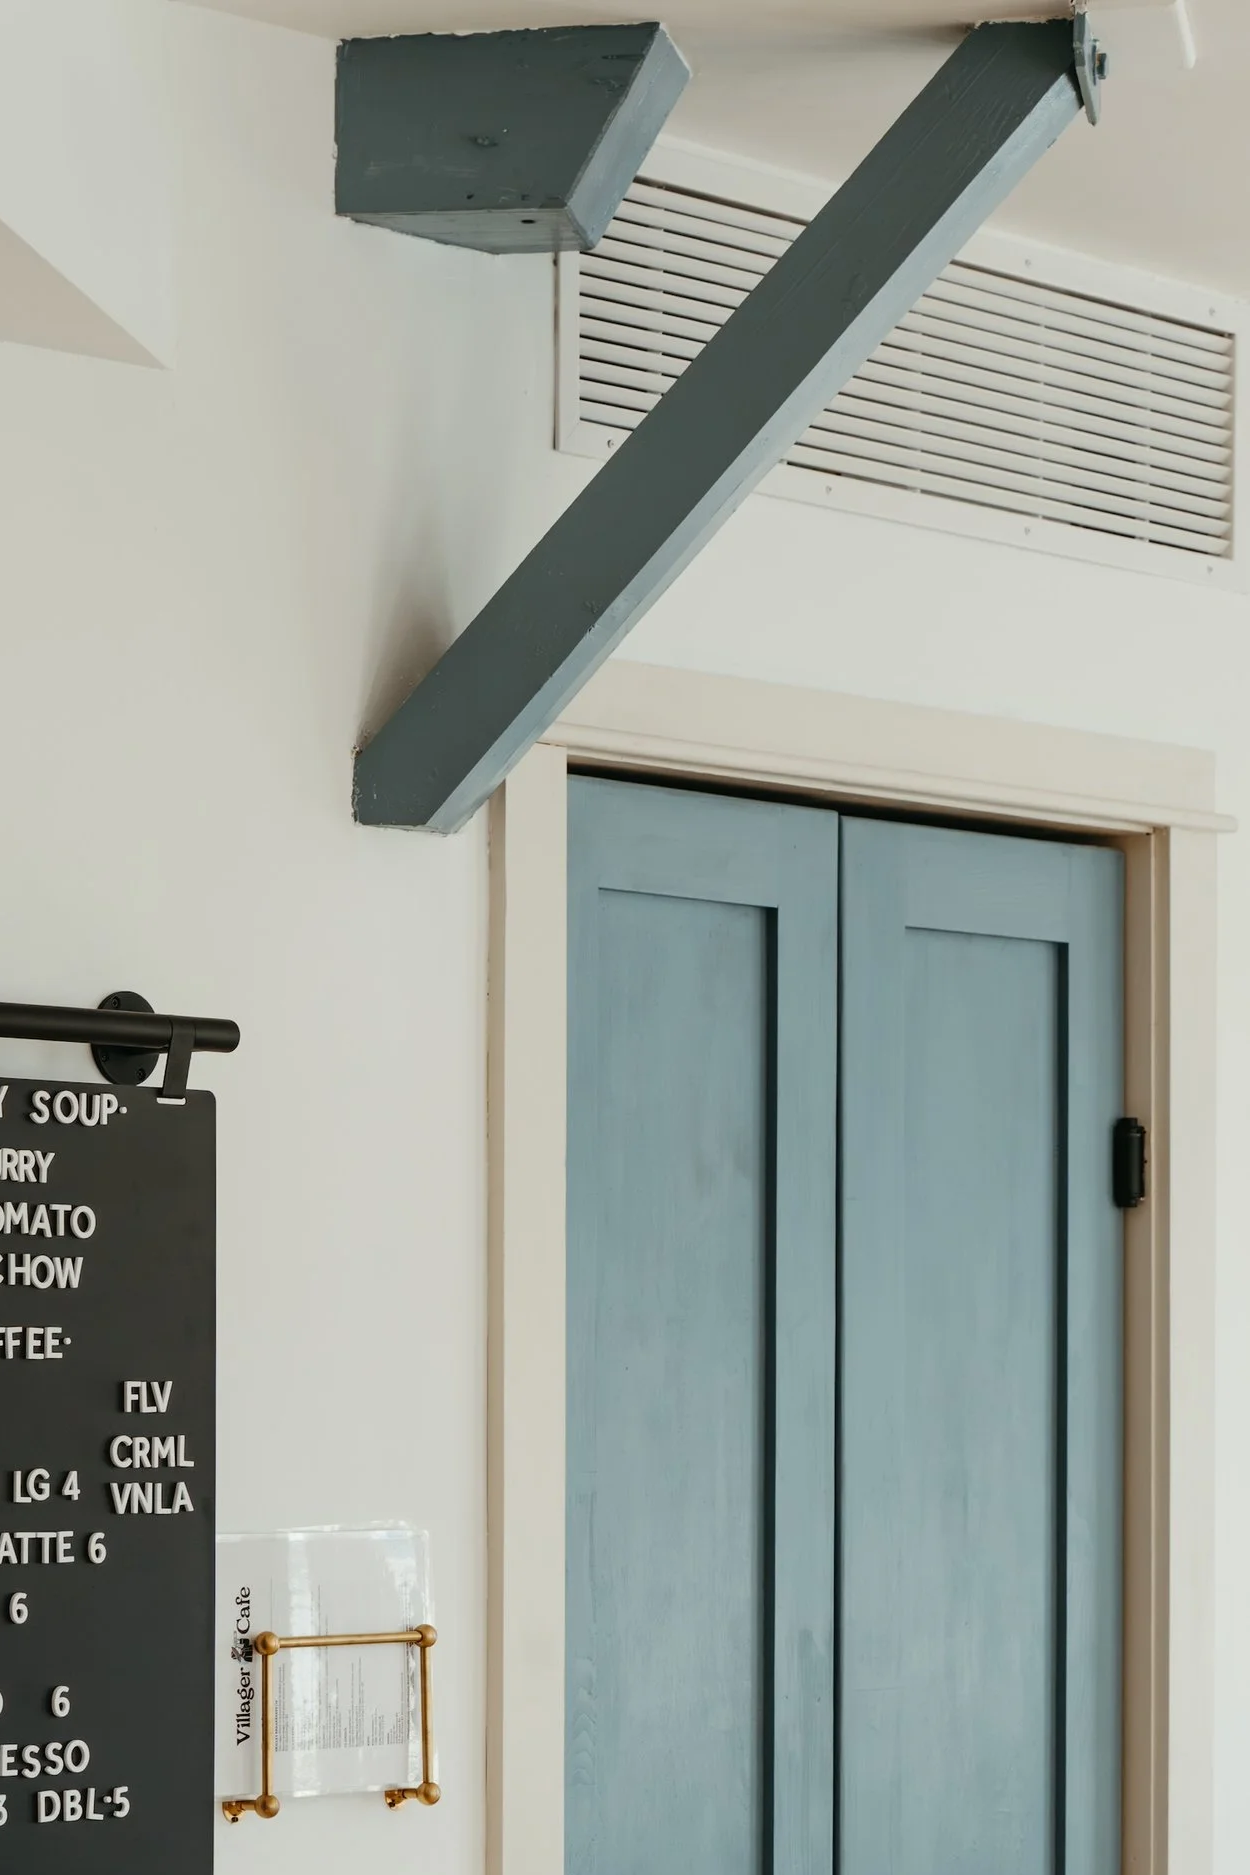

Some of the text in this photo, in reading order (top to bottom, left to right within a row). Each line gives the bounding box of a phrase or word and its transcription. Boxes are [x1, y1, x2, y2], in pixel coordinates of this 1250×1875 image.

[123, 1380, 173, 1414] FLV
[110, 1434, 195, 1469] CRML
[13, 1467, 51, 1504] LG
[61, 1470, 81, 1501] 4
[110, 1481, 195, 1515] VNLA
[88, 1531, 107, 1564] 6
[9, 1592, 29, 1625] 6
[235, 1586, 255, 1747] Villager Cafe
[51, 1685, 71, 1718] 6
